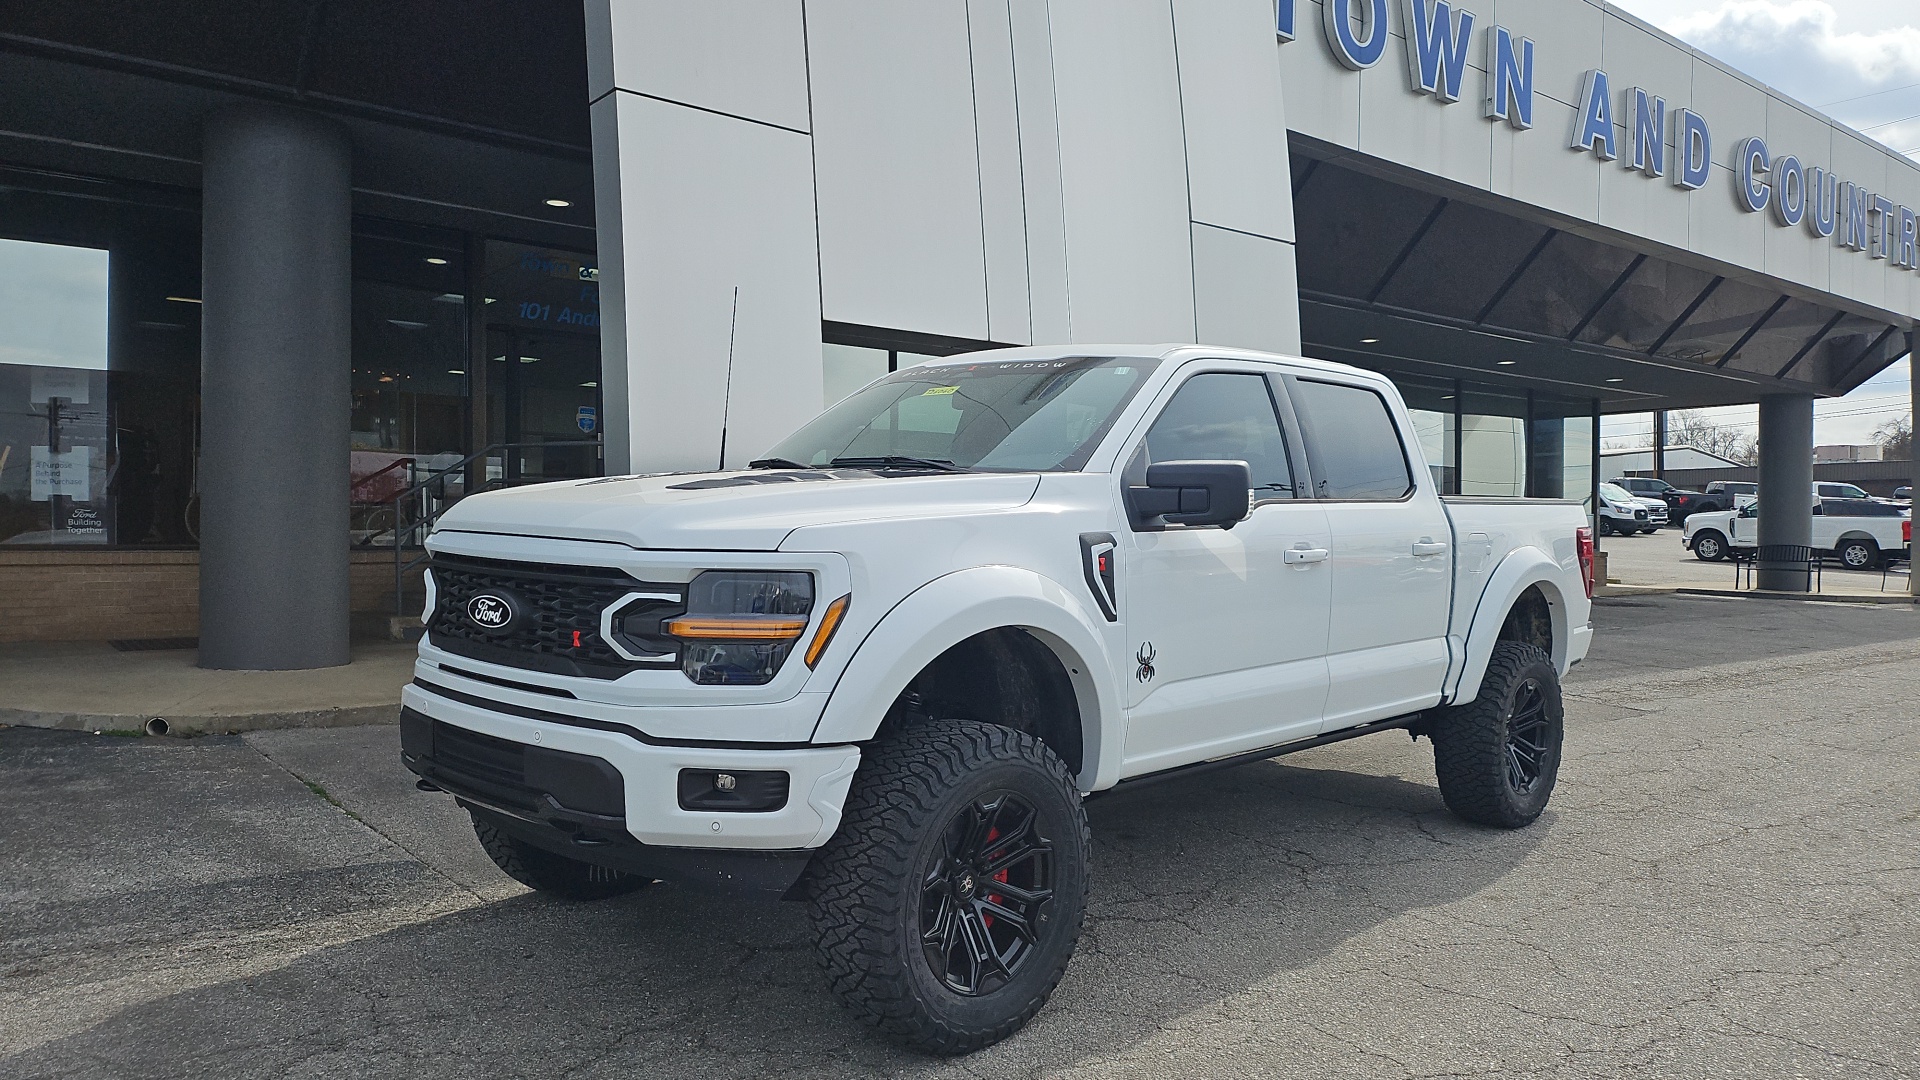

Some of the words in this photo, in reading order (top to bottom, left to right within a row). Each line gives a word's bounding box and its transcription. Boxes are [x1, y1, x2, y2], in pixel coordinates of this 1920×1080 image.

[1571, 69, 1713, 191] AND
[1736, 136, 1920, 271] COUNTR
[519, 301, 551, 321] 101
[557, 306, 600, 327] And
[1000, 362, 1068, 370] WIDOW
[42, 462, 73, 470] Purpose
[35, 470, 61, 478] Behind
[35, 478, 48, 486] the
[50, 478, 83, 486] Purchase
[72, 508, 97, 519] Ford
[68, 519, 102, 527] Building
[67, 526, 103, 535] Together
[475, 599, 503, 623] Ford
